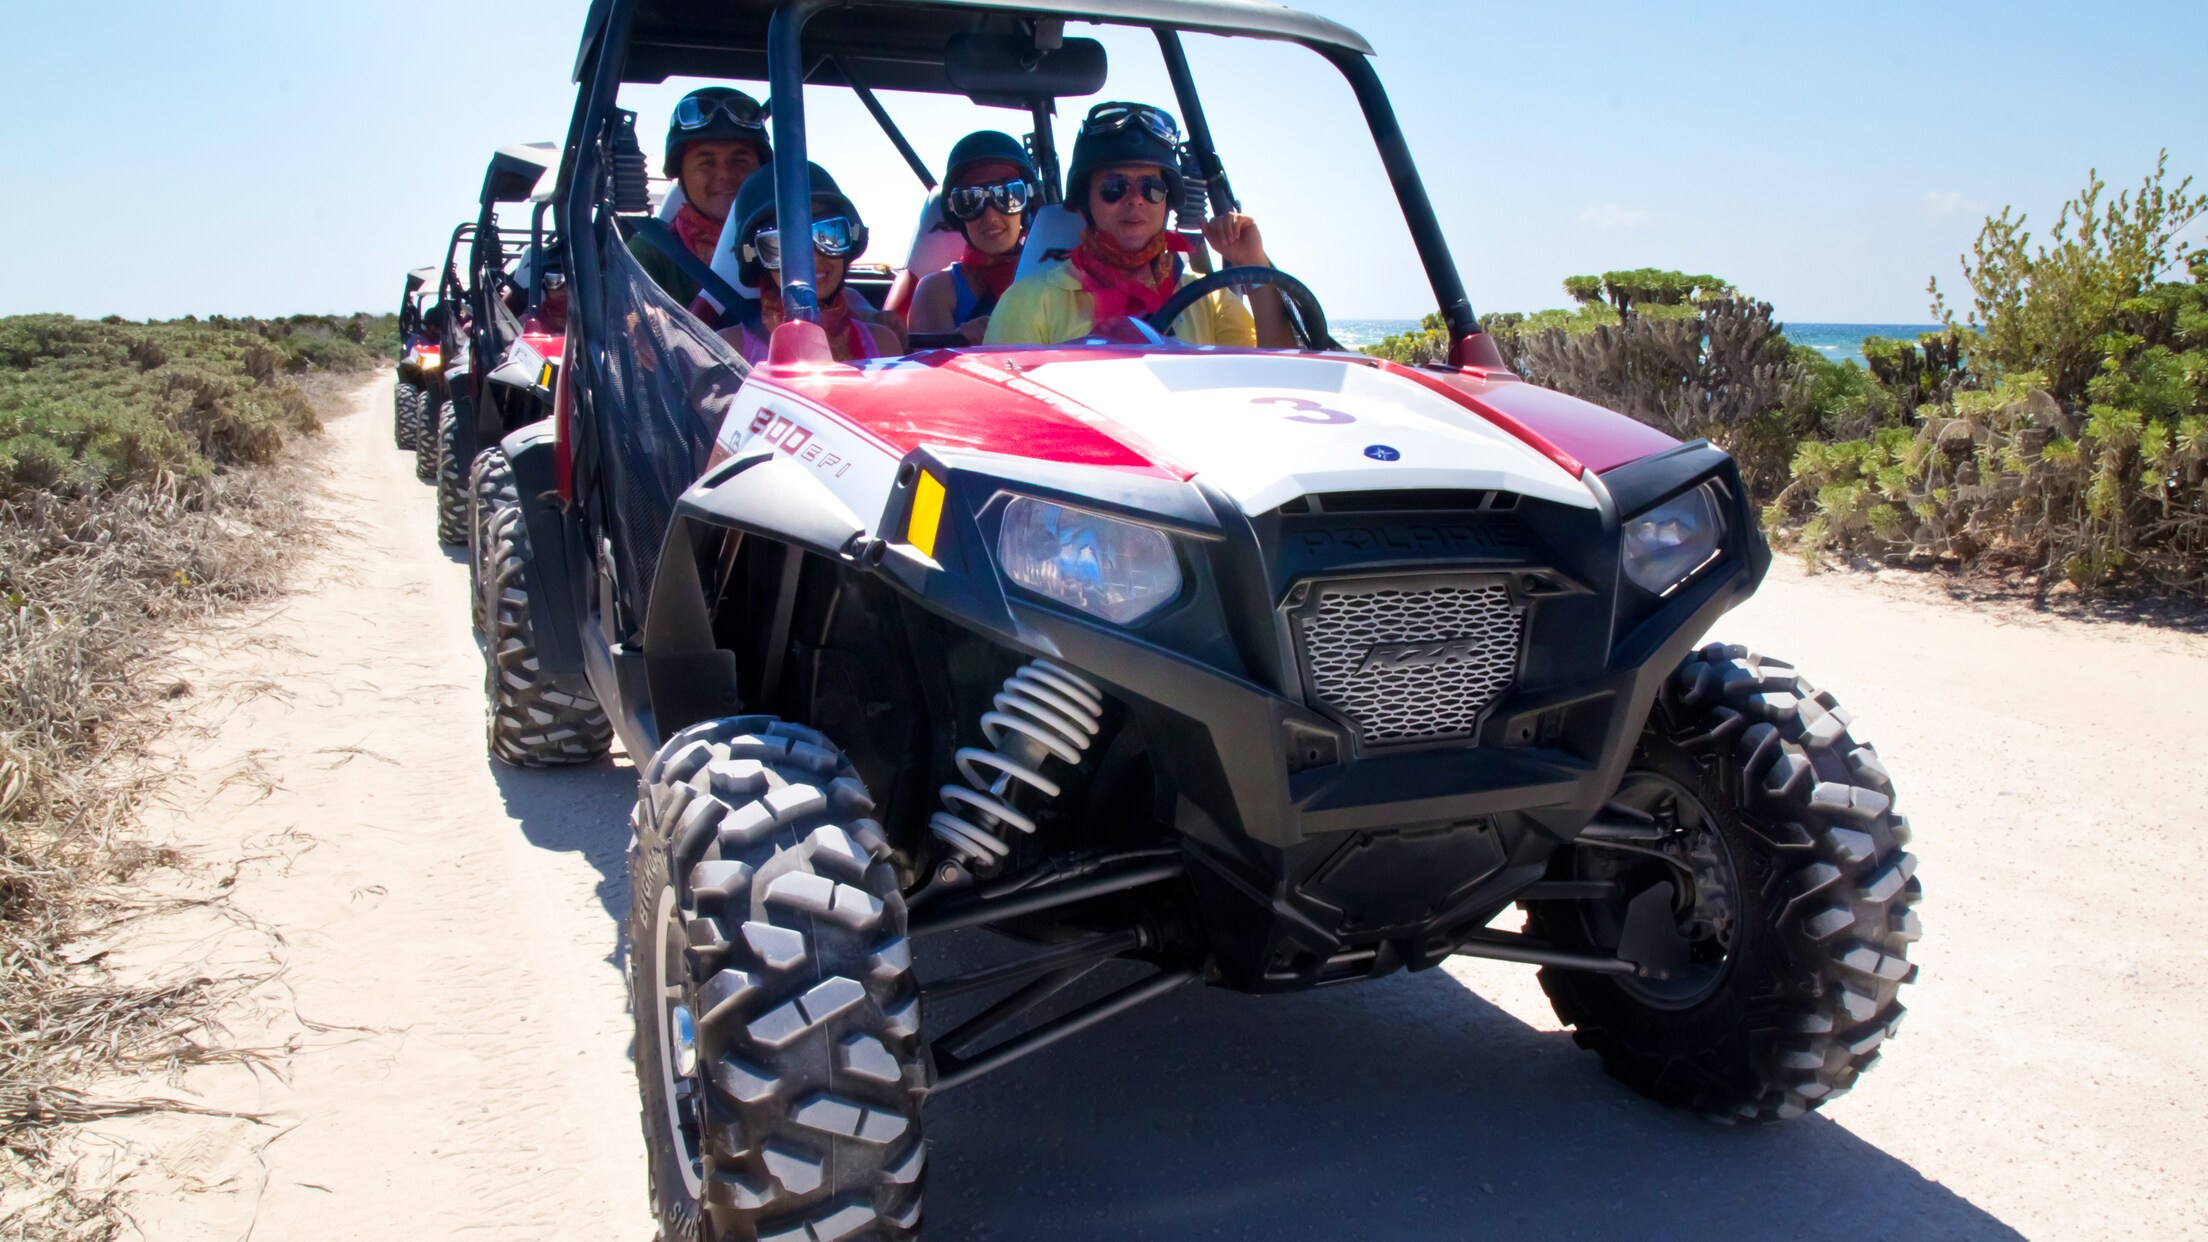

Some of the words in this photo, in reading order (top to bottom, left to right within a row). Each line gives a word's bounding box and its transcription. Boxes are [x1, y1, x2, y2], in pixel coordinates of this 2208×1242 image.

[1250, 397, 1356, 424] 3
[748, 407, 814, 456] 800
[801, 443, 852, 478] EFI
